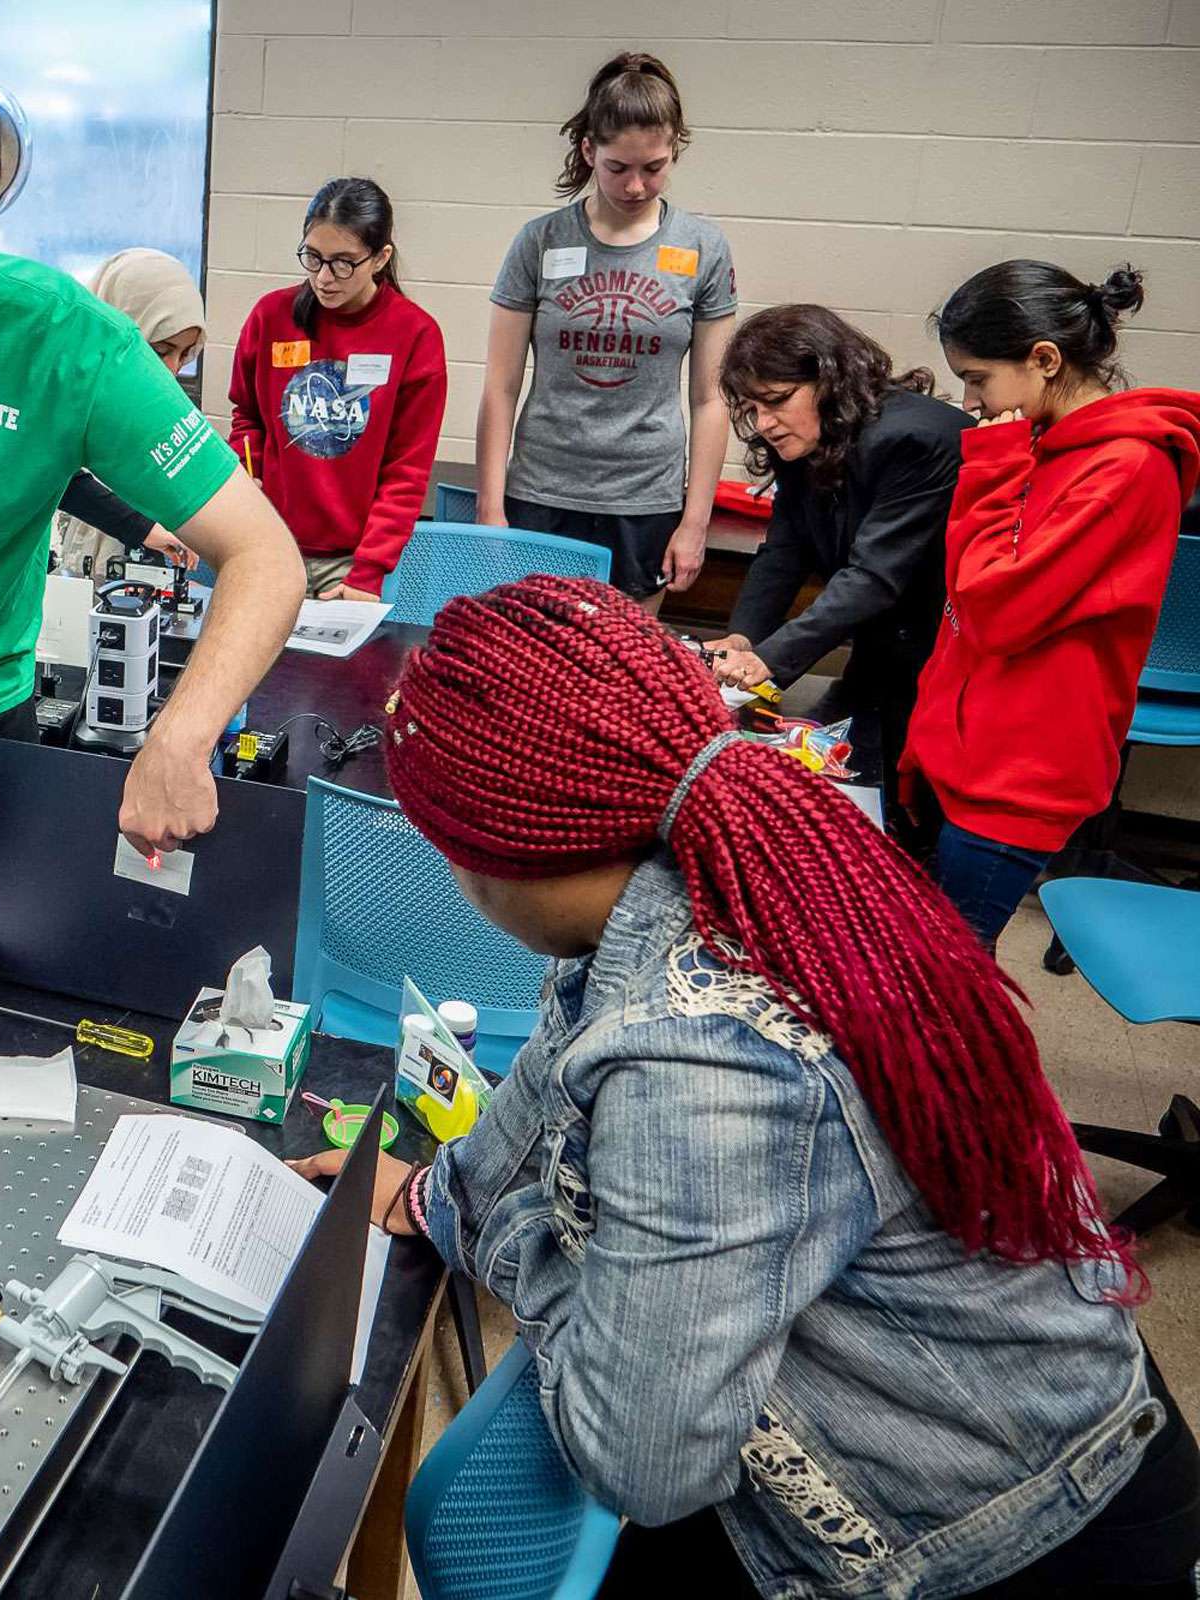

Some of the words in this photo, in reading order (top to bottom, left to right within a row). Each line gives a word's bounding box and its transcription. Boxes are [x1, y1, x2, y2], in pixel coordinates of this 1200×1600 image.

[555, 269, 677, 316] BLOOMFIELD
[559, 329, 662, 355] BENGALS
[575, 354, 638, 369] BASKETBALL
[288, 394, 364, 423] NASA
[150, 442, 174, 466] It's
[170, 422, 188, 447] all
[192, 1069, 261, 1092] KIMTECH
